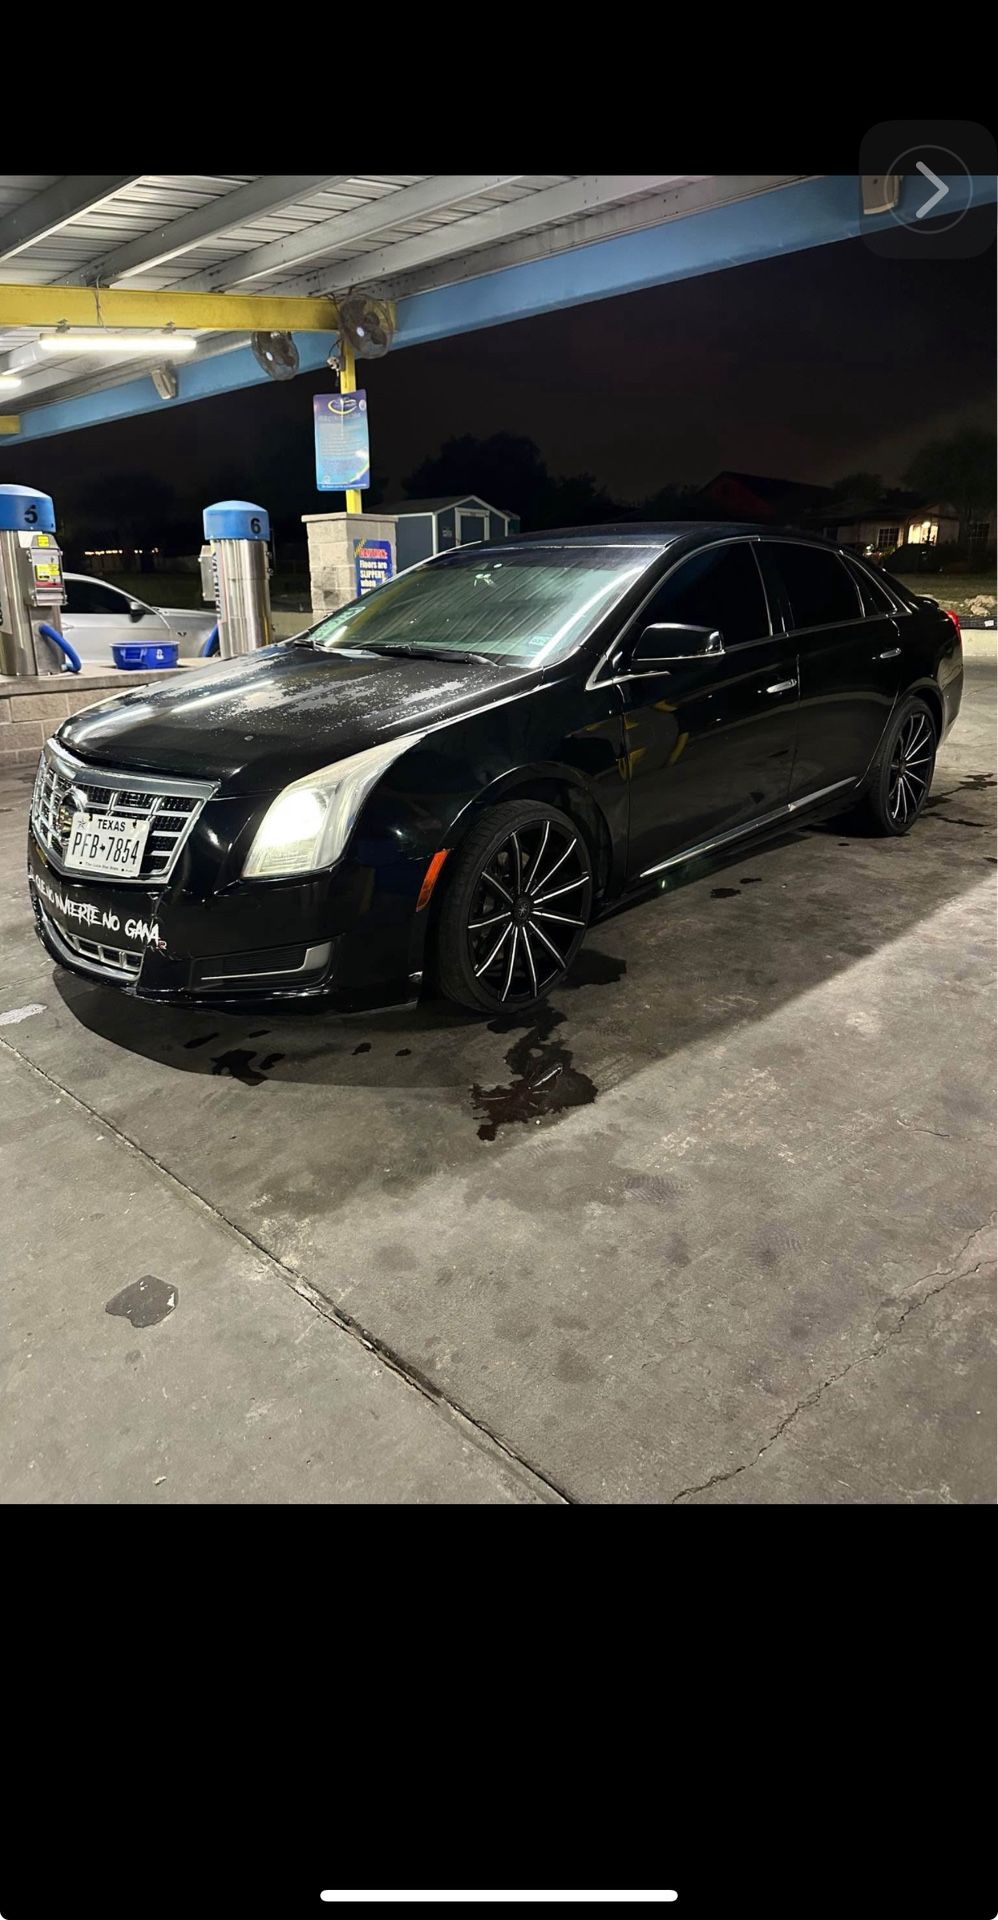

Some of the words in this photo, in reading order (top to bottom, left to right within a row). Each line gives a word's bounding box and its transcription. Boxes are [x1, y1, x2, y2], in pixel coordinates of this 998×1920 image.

[24, 504, 38, 524] 5
[250, 517, 262, 535] 6
[360, 560, 378, 569] Floors
[98, 819, 126, 832] TEXAS
[54, 893, 103, 927] INVIERTE
[102, 908, 120, 931] NO
[124, 919, 161, 946] GANA
